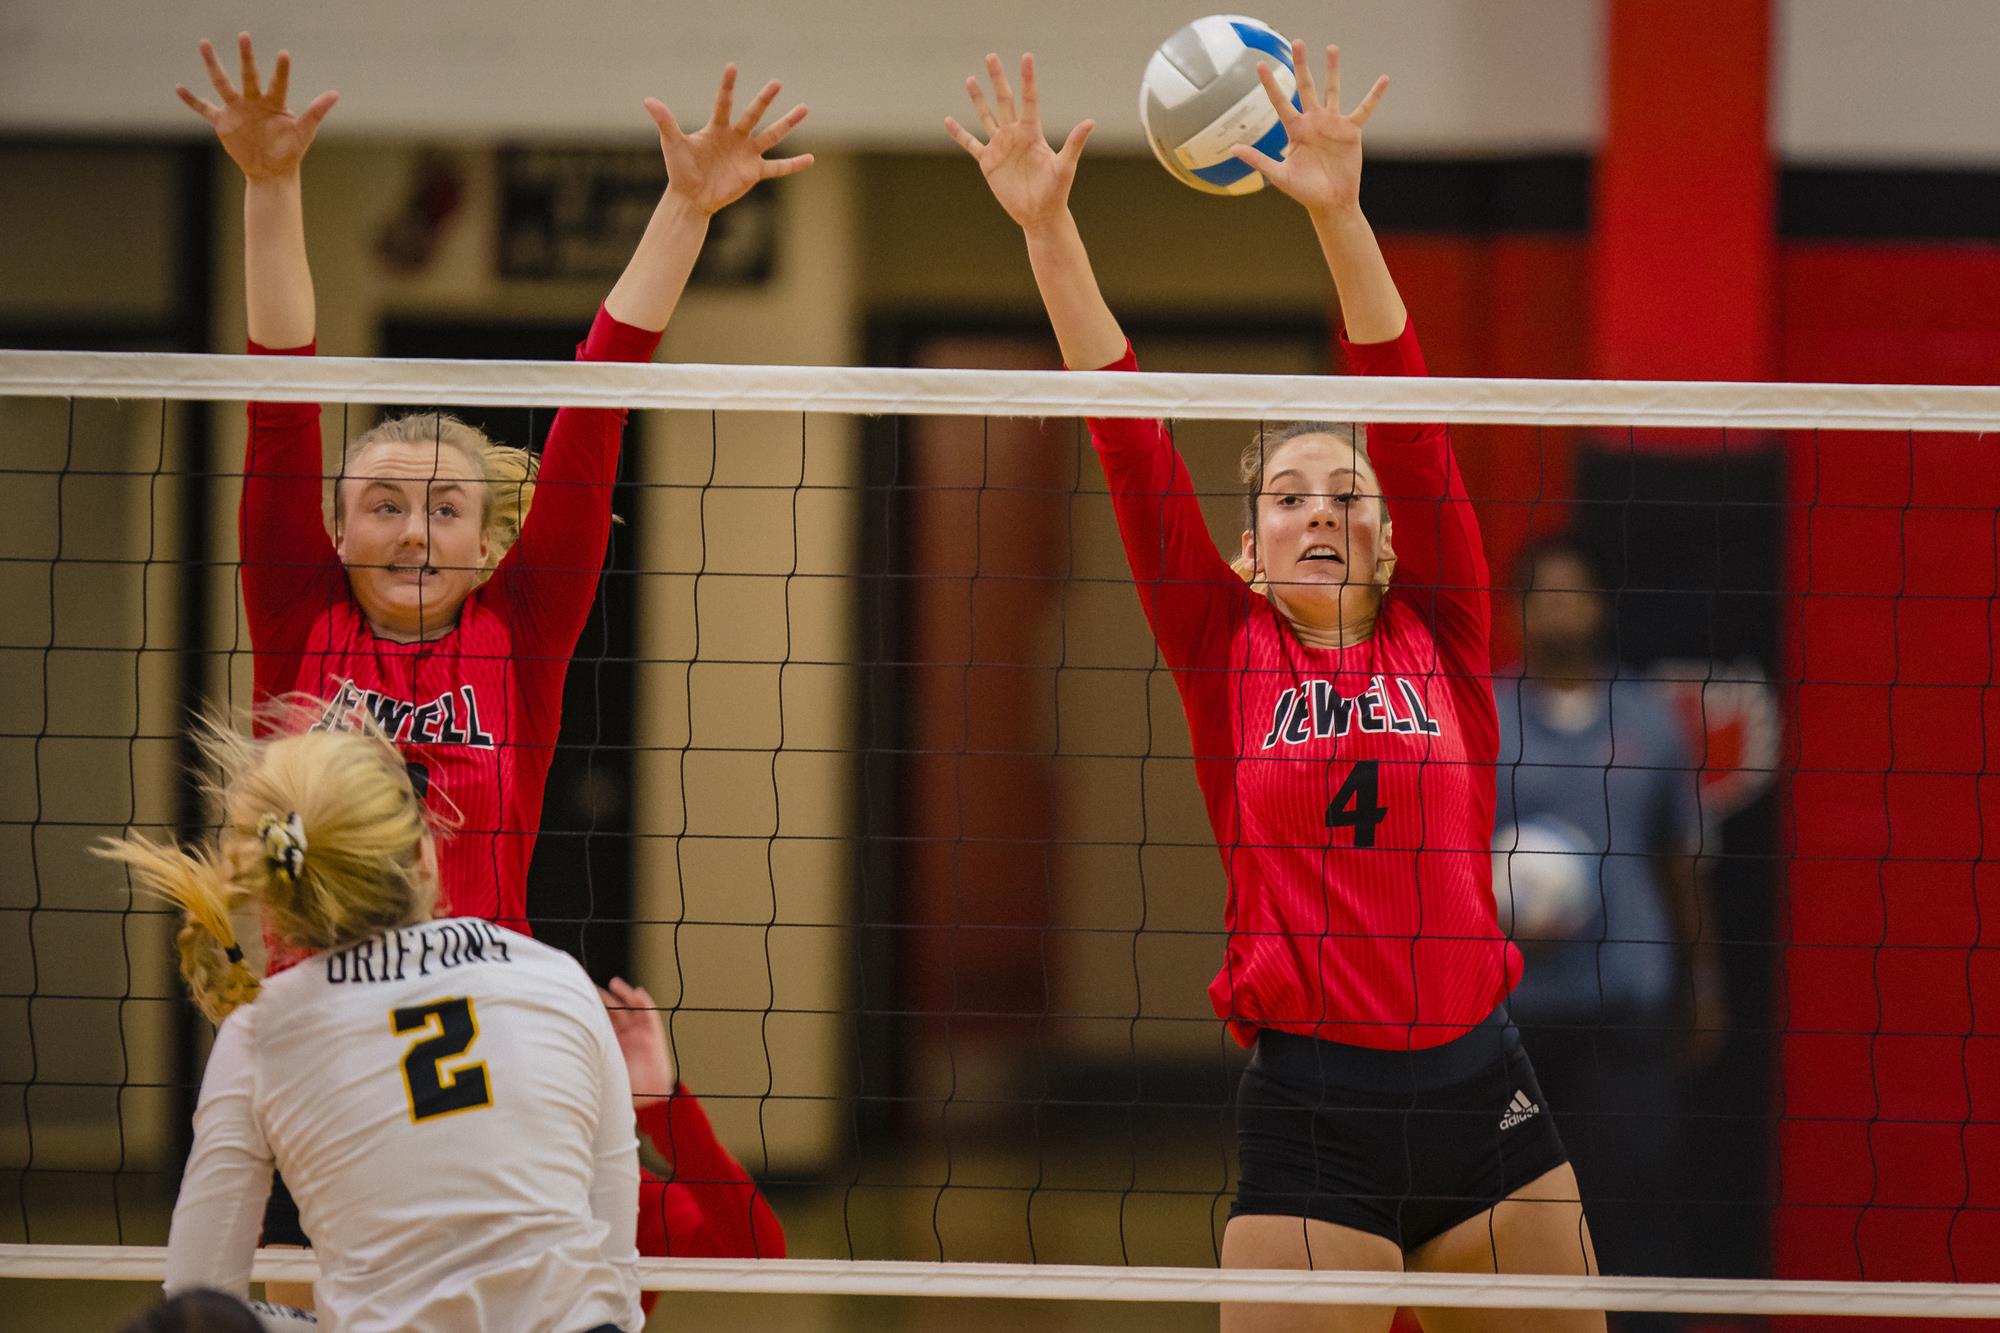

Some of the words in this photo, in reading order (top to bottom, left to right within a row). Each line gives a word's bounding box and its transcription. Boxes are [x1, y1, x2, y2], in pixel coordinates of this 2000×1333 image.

[1261, 675, 1441, 750] JEWELL
[1325, 759, 1388, 848] 4
[389, 995, 494, 1123] 2
[1500, 1104, 1540, 1130] adidas
